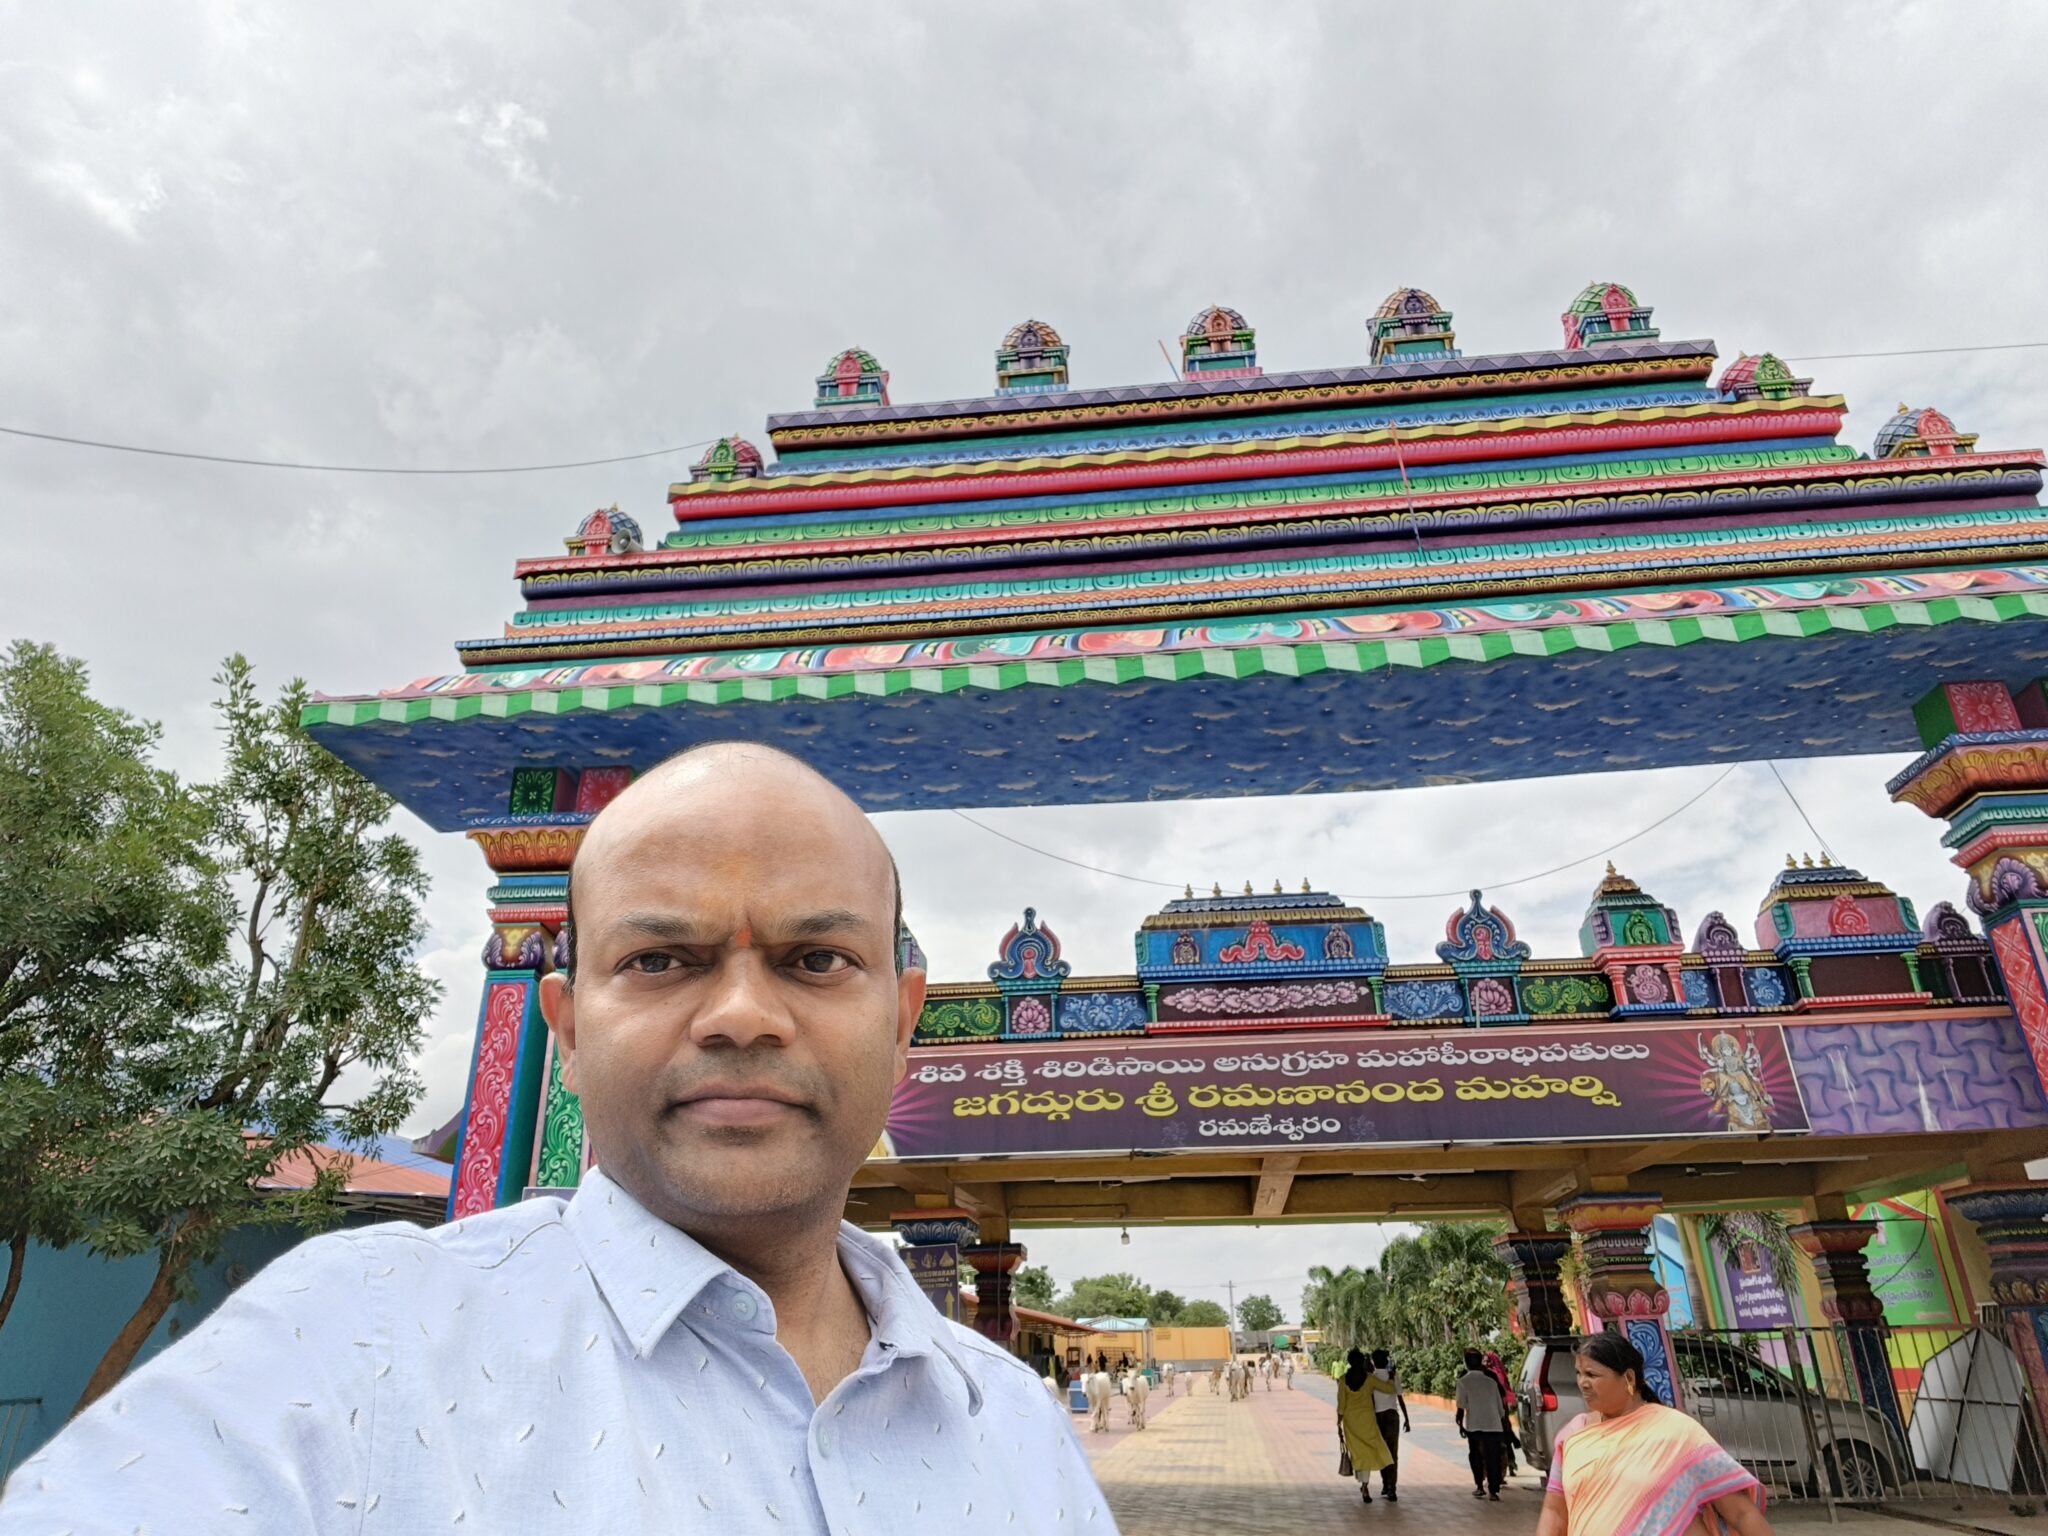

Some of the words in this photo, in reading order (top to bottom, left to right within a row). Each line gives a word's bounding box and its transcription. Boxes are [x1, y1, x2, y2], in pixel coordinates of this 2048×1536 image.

[910, 1063, 967, 1083] శివ
[974, 1059, 1028, 1087] శక్తి
[1033, 1057, 1206, 1079] శిరిడిసాయి
[1213, 1050, 1350, 1076] అనుగ్రహ
[1356, 1042, 1650, 1069] మహాపీఠాధిపతులు
[953, 1088, 1125, 1121] జగద్గురు
[1134, 1081, 1179, 1117] శ్రీ
[1188, 1077, 1445, 1108] రమణానంద
[1454, 1074, 1622, 1107] మహర్షి
[1198, 1113, 1342, 1142] రమణేశ్వరం
